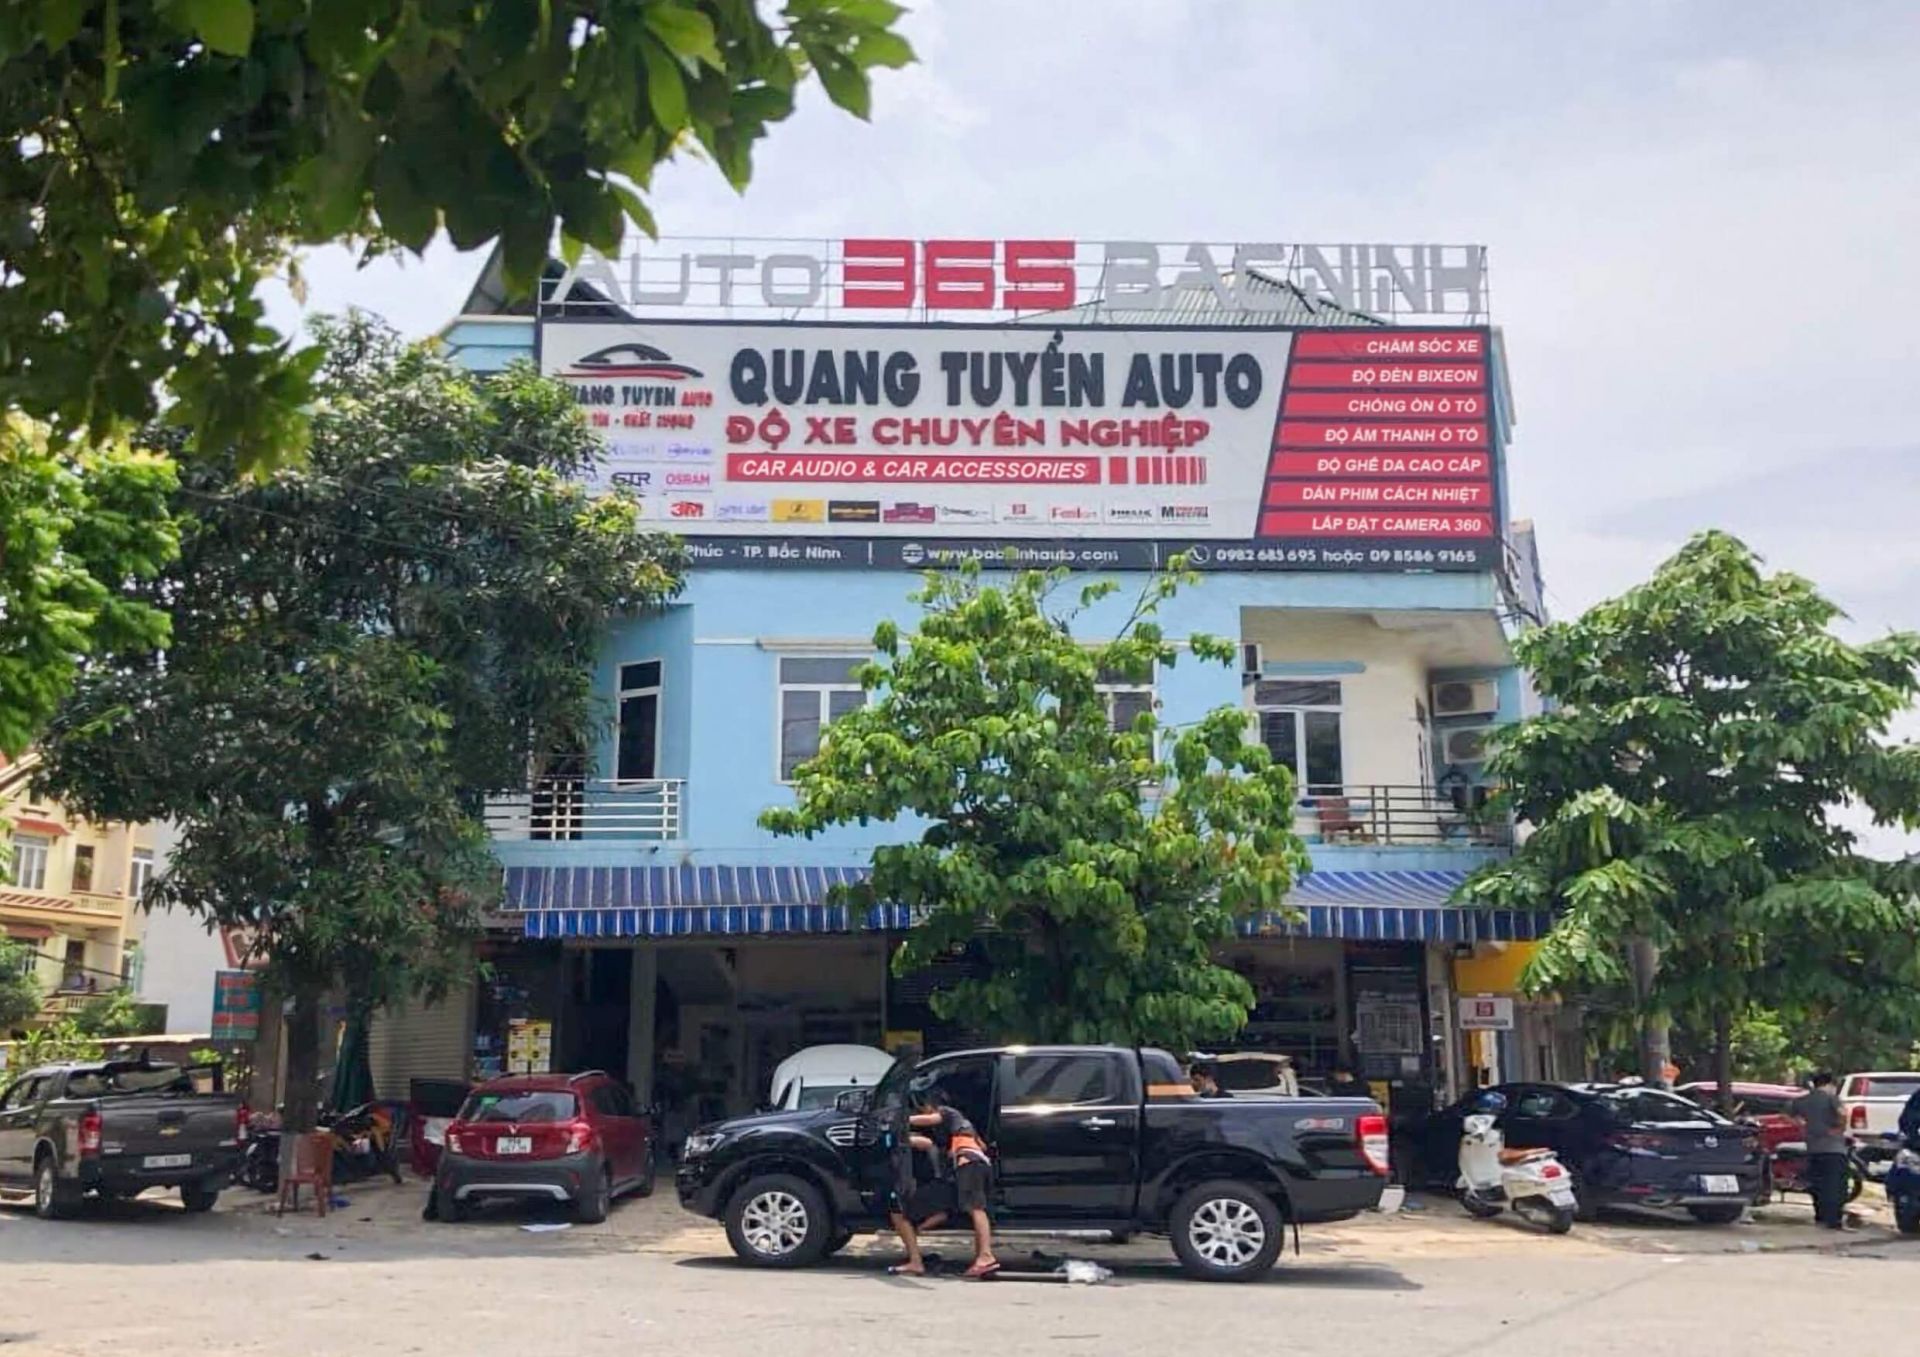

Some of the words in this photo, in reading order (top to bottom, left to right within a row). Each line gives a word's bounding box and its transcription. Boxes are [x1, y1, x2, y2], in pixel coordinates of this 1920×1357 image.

[551, 252, 822, 307] AUTO
[843, 239, 1076, 310] 365
[1367, 338, 1414, 353] CHĂM
[1418, 337, 1452, 353] SÓC
[1456, 339, 1478, 352] XE
[730, 348, 921, 408] QUANG
[940, 328, 1105, 408] TUYỂN
[1122, 353, 1263, 410] AUTO
[1352, 367, 1376, 385] ĐỘ
[1380, 366, 1413, 382] ĐÈN
[1417, 369, 1478, 382] BIXEON
[1348, 397, 1406, 412] CHỐNG
[1438, 397, 1451, 412] Ô
[1455, 397, 1478, 412] TÔ
[726, 408, 791, 450] ĐỘ
[805, 417, 857, 445] XE
[872, 410, 1045, 446] CHUYÊN
[1060, 411, 1210, 453] NGHIỆP
[1325, 427, 1348, 444] ĐỘ
[1352, 427, 1377, 441] ÂM
[1381, 429, 1435, 441] THANH
[1439, 427, 1452, 441] Ô
[1457, 427, 1478, 441] TÔ
[742, 460, 786, 476] CAR
[789, 461, 857, 477] AUDIO
[862, 461, 876, 477] &
[883, 461, 927, 478] CAR
[932, 462, 1087, 479] ACCESSORIES
[1317, 457, 1341, 474] ĐỘ
[1345, 456, 1379, 472] GHẾ
[1382, 459, 1405, 471] DA
[1409, 459, 1444, 472] CAO
[1448, 456, 1481, 472] CẤP
[666, 473, 710, 486] OSRAM
[1303, 485, 1336, 500] DÁN
[1340, 488, 1378, 500] PHIM
[1383, 486, 1427, 500] CÁCH
[1432, 487, 1480, 503] NHIỆT
[671, 501, 704, 517] 3M
[1312, 515, 1343, 531] LẮP
[1347, 517, 1379, 533] ĐẶT
[1383, 518, 1450, 531] CAMERA
[1455, 519, 1481, 532] 360
[684, 543, 724, 558] Phúc
[806, 546, 841, 559] Ninh
[927, 546, 1119, 562] www.bacinhauto.com
[1216, 549, 1254, 562] 0982
[1322, 547, 1363, 564] hoặc
[1369, 549, 1390, 562] 09
